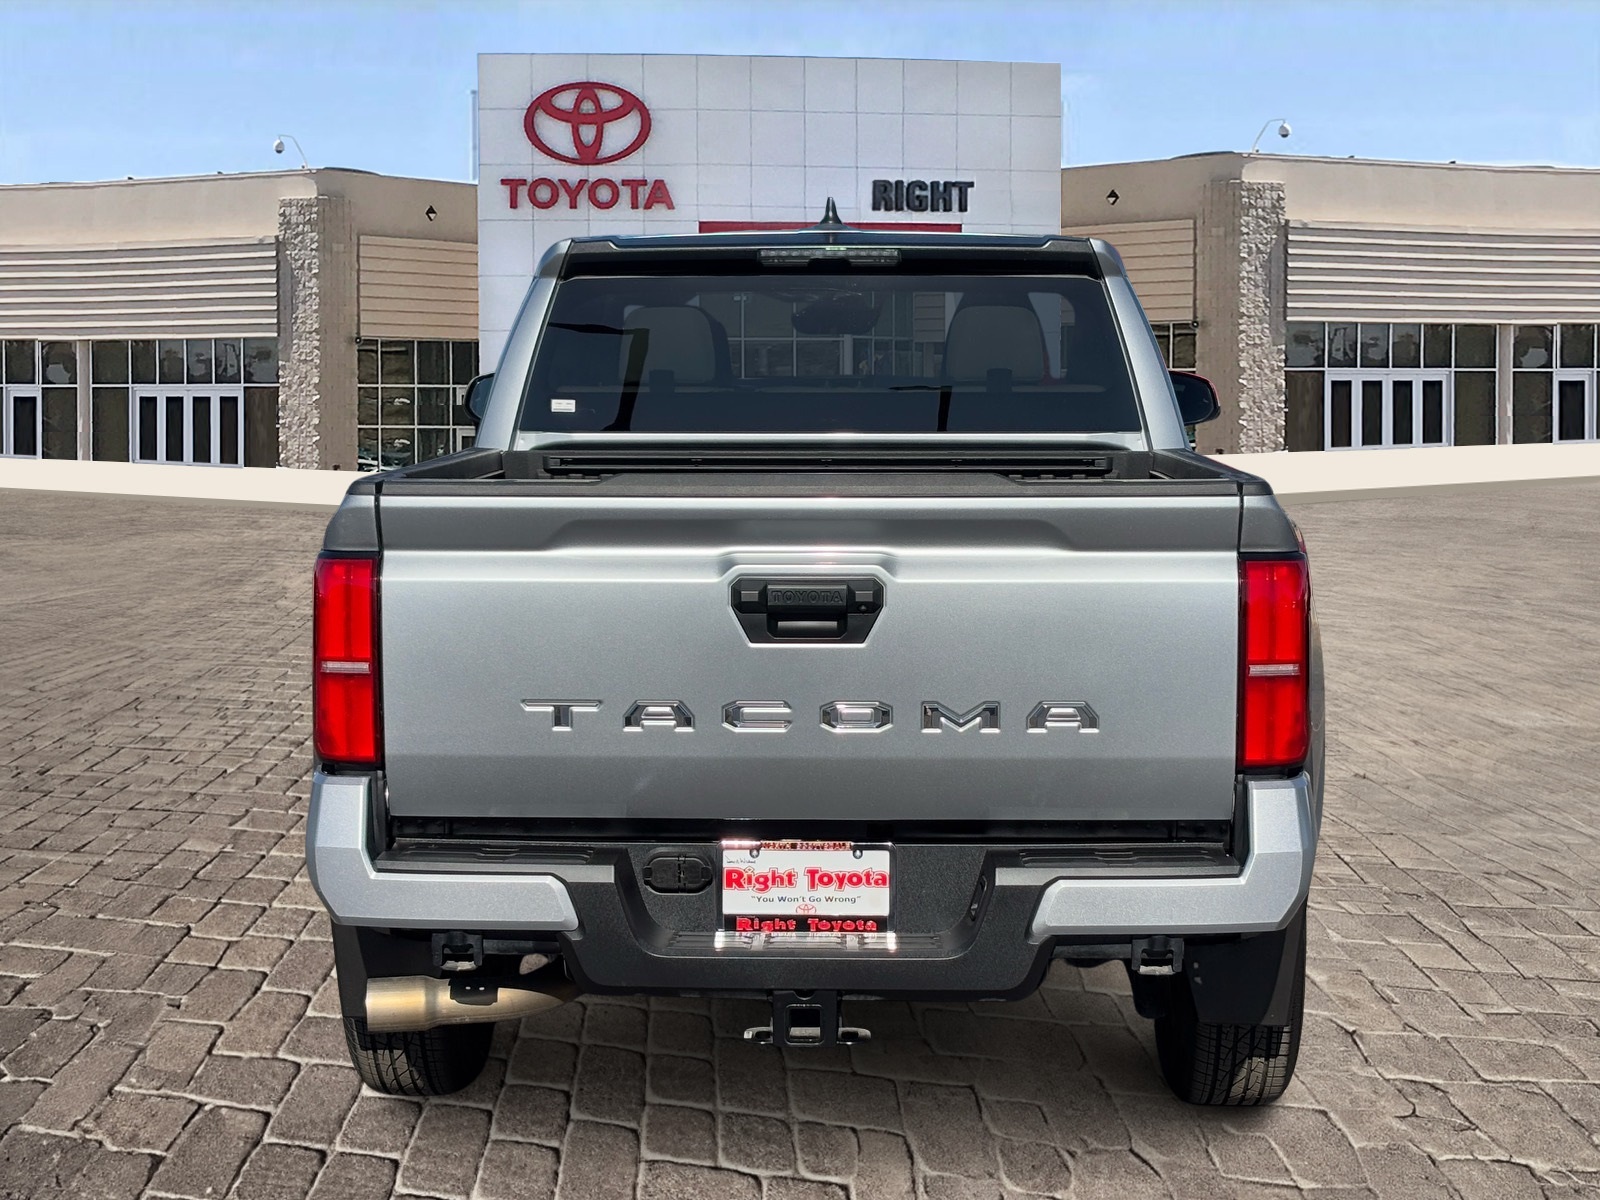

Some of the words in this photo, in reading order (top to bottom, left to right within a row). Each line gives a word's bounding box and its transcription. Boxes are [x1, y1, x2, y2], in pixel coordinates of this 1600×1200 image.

[500, 178, 675, 210] TOYOTA
[871, 179, 975, 213] RIGHT
[771, 590, 844, 604] TOYOTA
[520, 699, 1101, 734] TACOMA
[723, 866, 798, 894] Right
[804, 866, 890, 892] Toyota
[808, 895, 822, 904] Go
[735, 917, 797, 933] Right
[807, 917, 878, 932] Toyota
